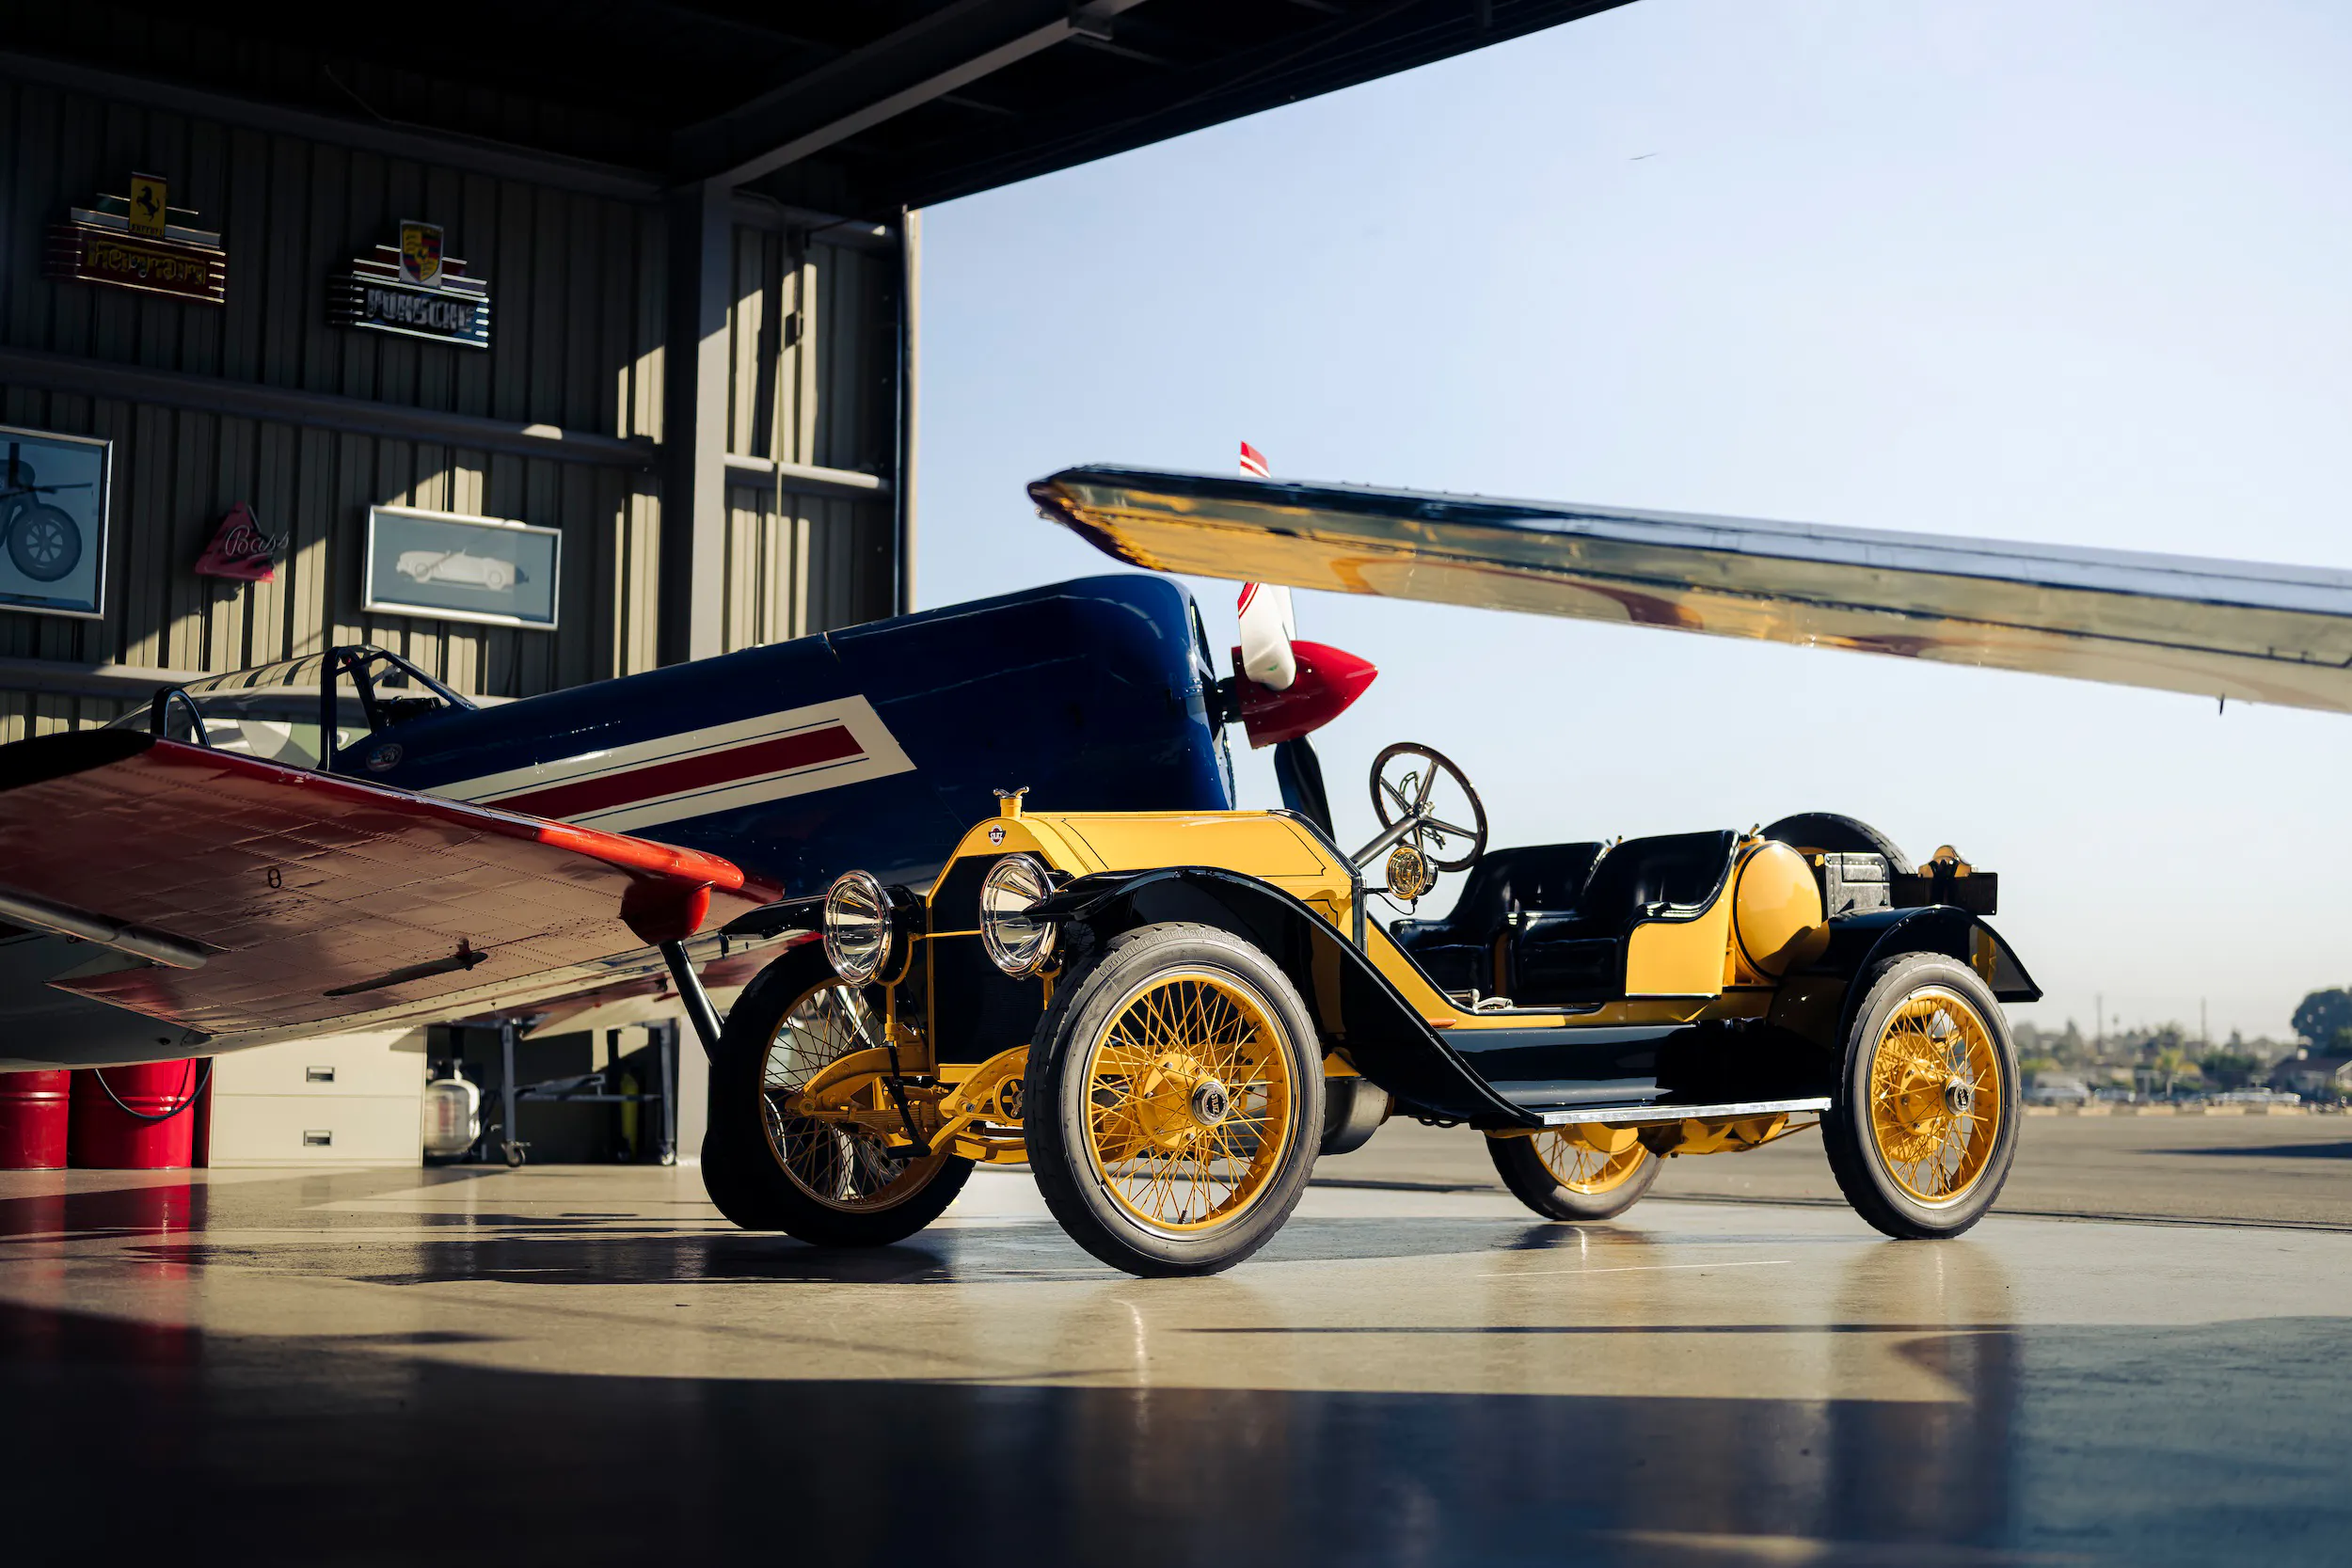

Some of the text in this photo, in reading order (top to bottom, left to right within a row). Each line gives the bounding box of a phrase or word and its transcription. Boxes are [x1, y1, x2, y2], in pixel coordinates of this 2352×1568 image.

[226, 525, 290, 557] Bass
[268, 868, 281, 889] 8
[1211, 1093, 1220, 1115] STUTZ
